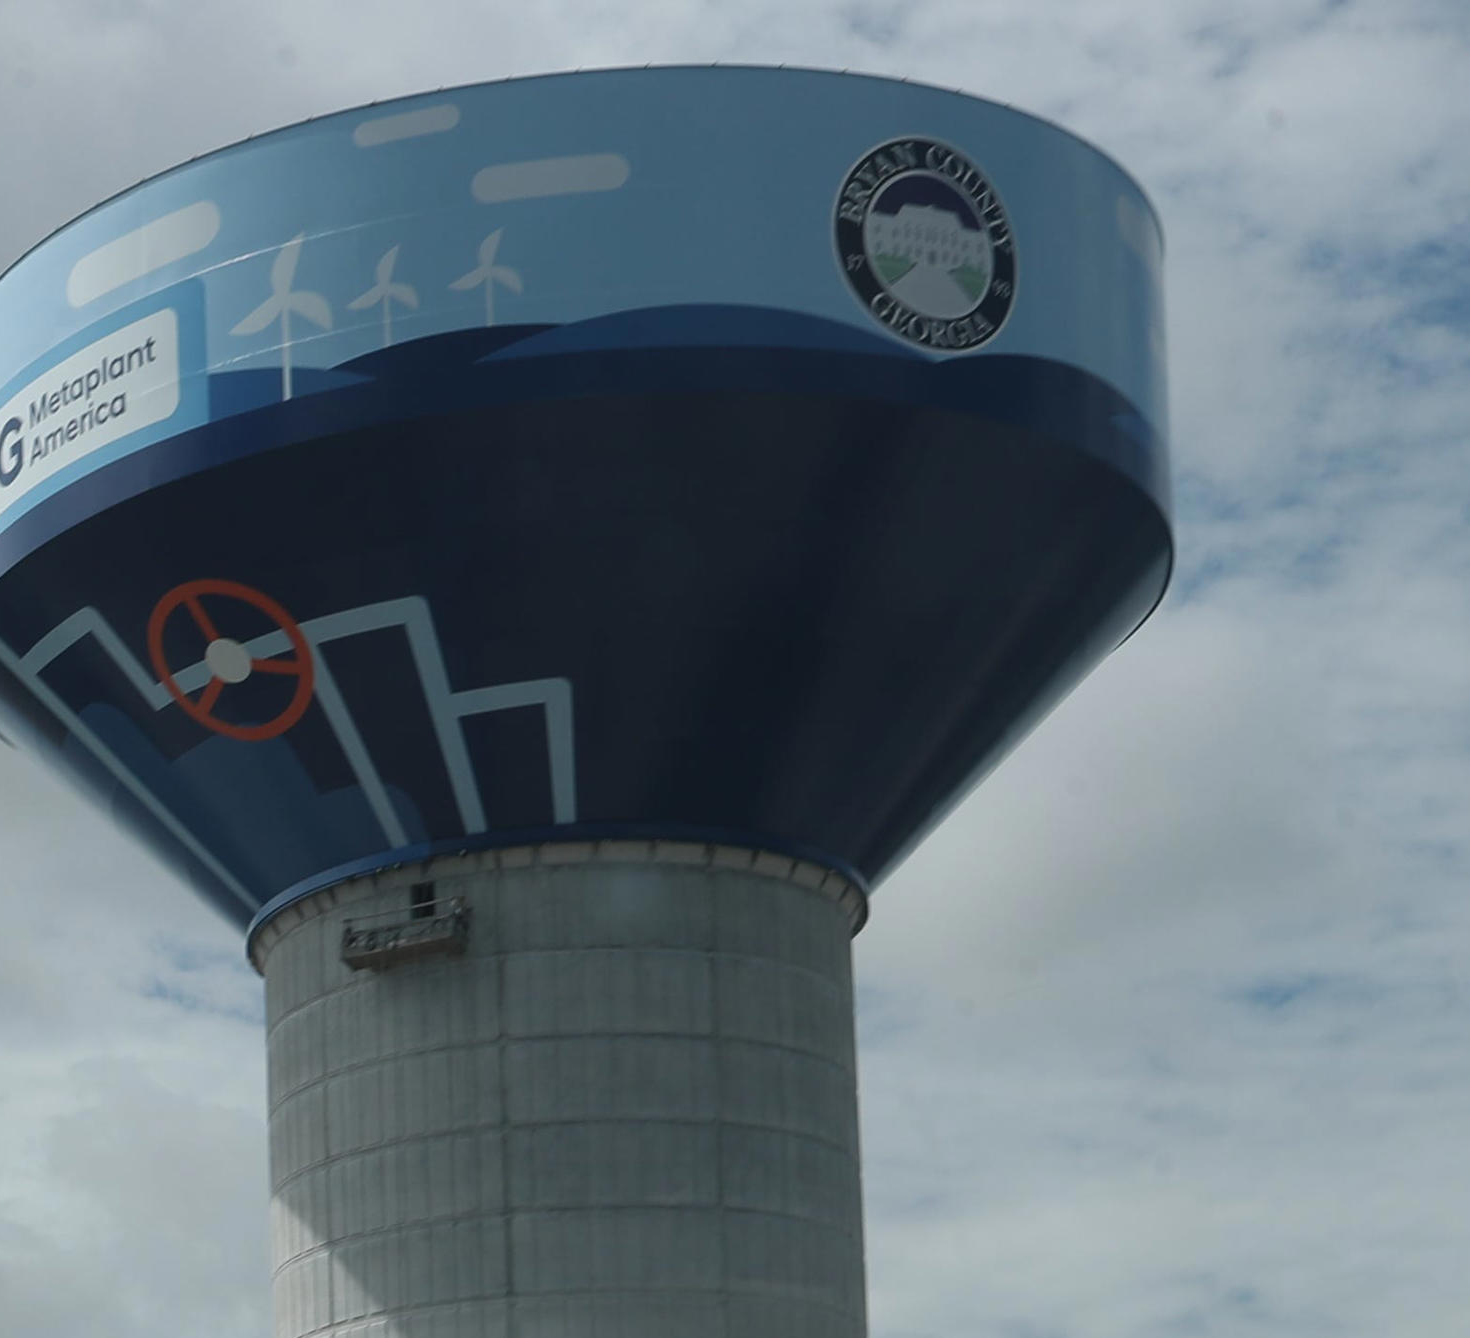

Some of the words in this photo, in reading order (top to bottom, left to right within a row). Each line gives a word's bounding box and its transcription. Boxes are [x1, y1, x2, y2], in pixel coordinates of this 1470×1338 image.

[839, 142, 916, 224] BRYAN
[925, 144, 1012, 254] COUNTY
[28, 336, 157, 430] Metaplant
[29, 392, 127, 467] America
